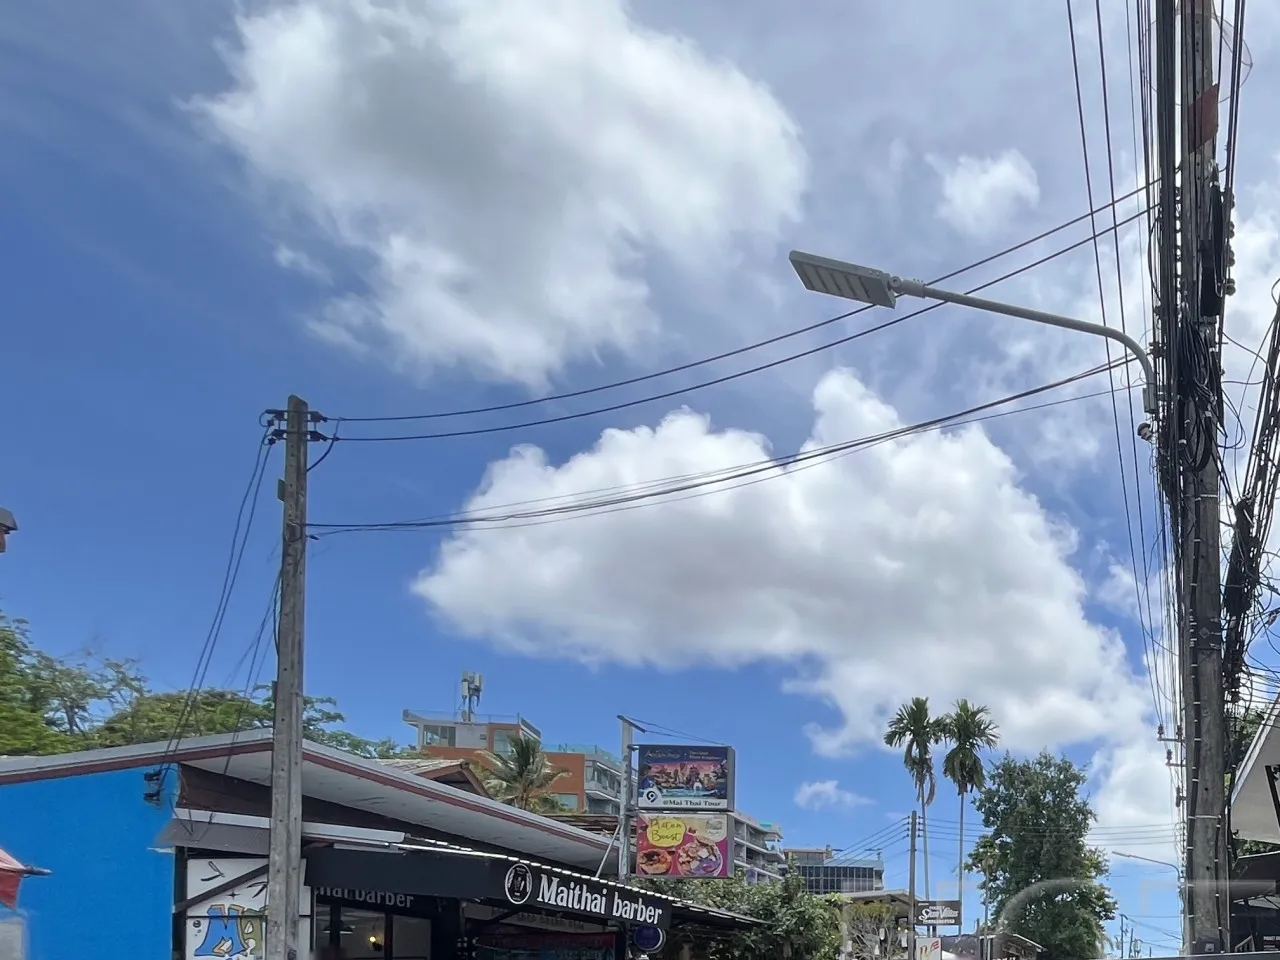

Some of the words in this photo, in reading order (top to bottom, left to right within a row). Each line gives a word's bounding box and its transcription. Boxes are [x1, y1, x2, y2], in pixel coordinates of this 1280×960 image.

[703, 799, 721, 807] Tour
[537, 873, 608, 916] Maithai
[612, 891, 664, 926] barber
